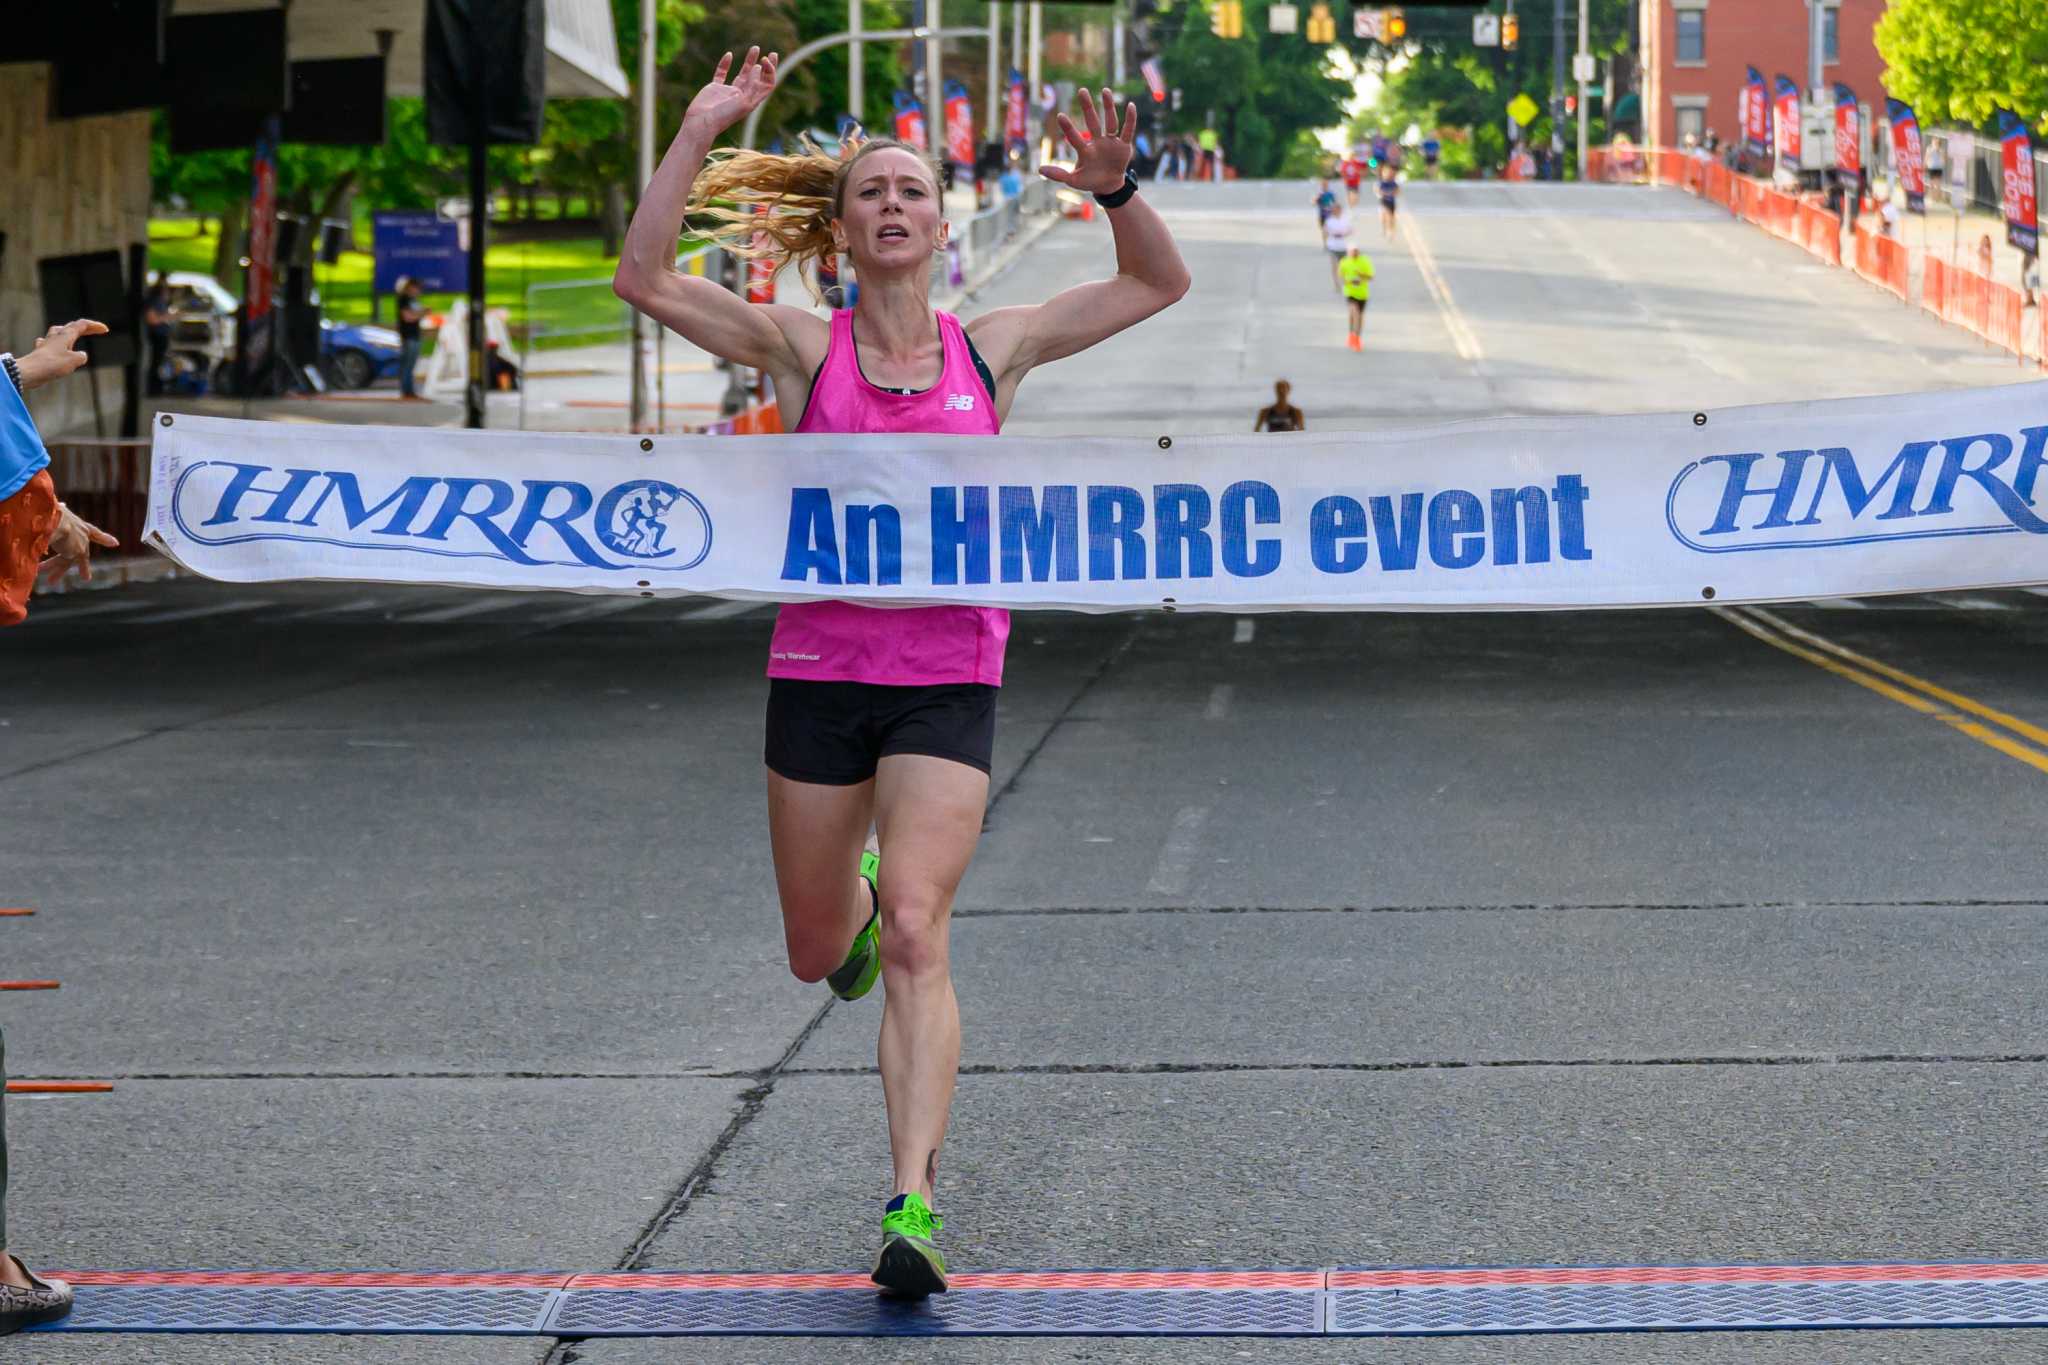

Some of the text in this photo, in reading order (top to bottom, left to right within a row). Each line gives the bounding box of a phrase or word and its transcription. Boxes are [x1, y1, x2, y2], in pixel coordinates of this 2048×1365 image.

[201, 460, 677, 571] HMRRC
[780, 474, 1593, 586] An HMRRC event
